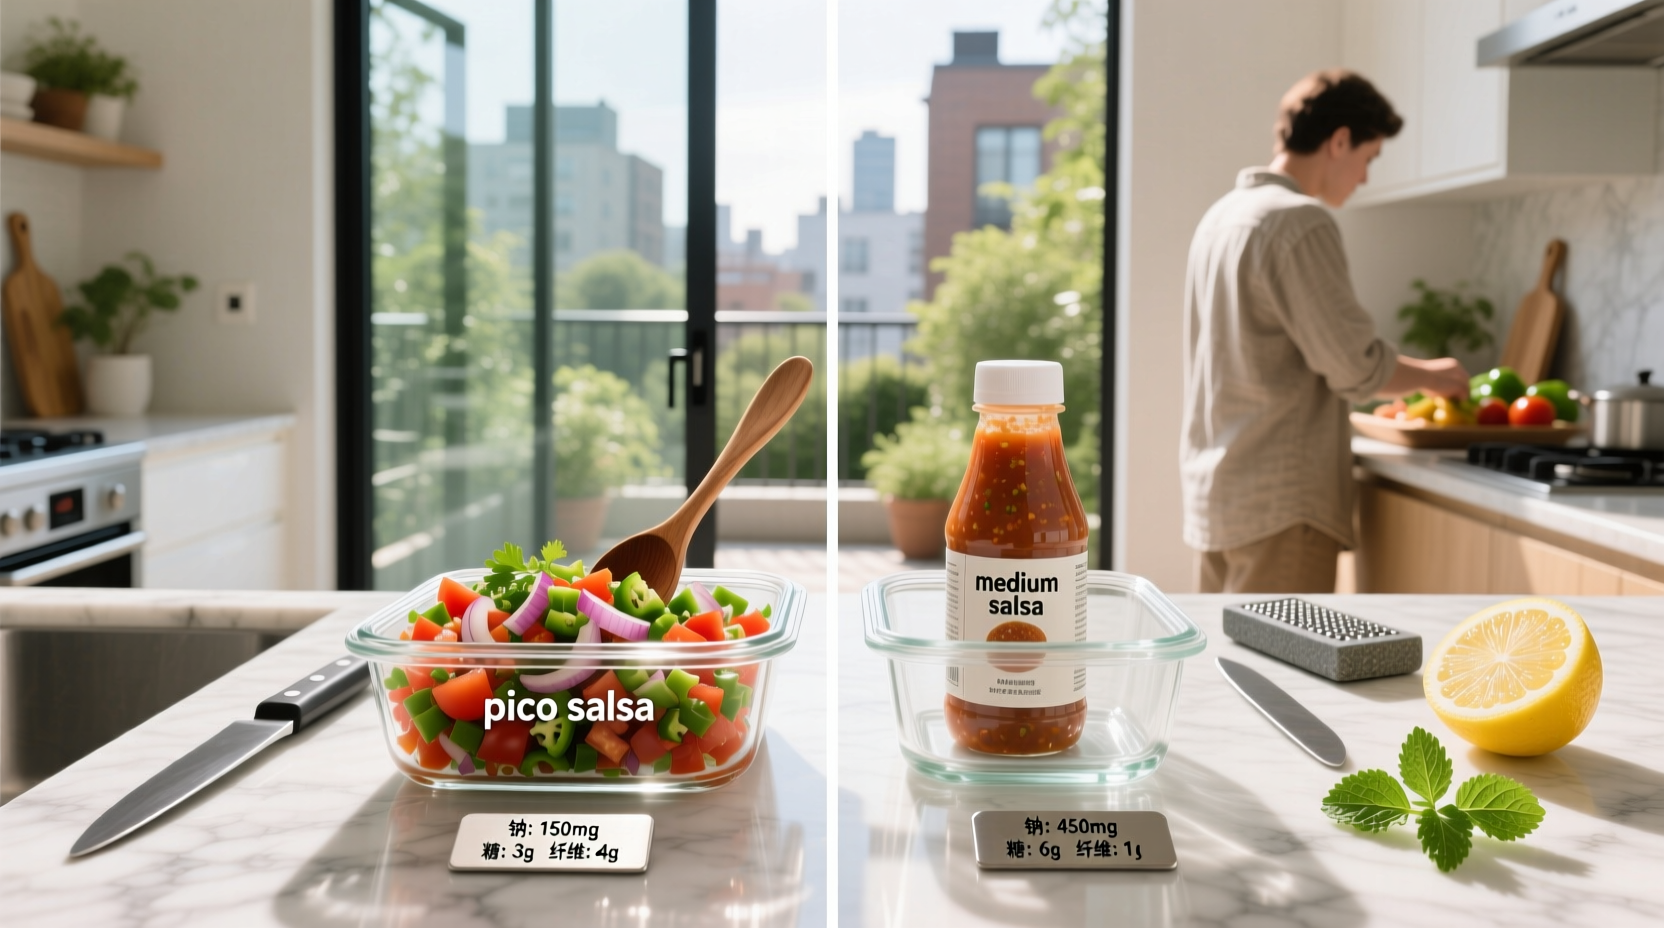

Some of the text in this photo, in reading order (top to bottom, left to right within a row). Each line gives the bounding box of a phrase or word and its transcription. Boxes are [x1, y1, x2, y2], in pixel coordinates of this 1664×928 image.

[975, 571, 1058, 592] medium
[988, 595, 1044, 616] salsa
[484, 689, 654, 730] pico salsa
[540, 821, 599, 840] 150mg
[1057, 818, 1118, 838] 450mg
[511, 842, 535, 863] 3g
[595, 843, 619, 863] 4g
[1039, 841, 1061, 861] 6g
